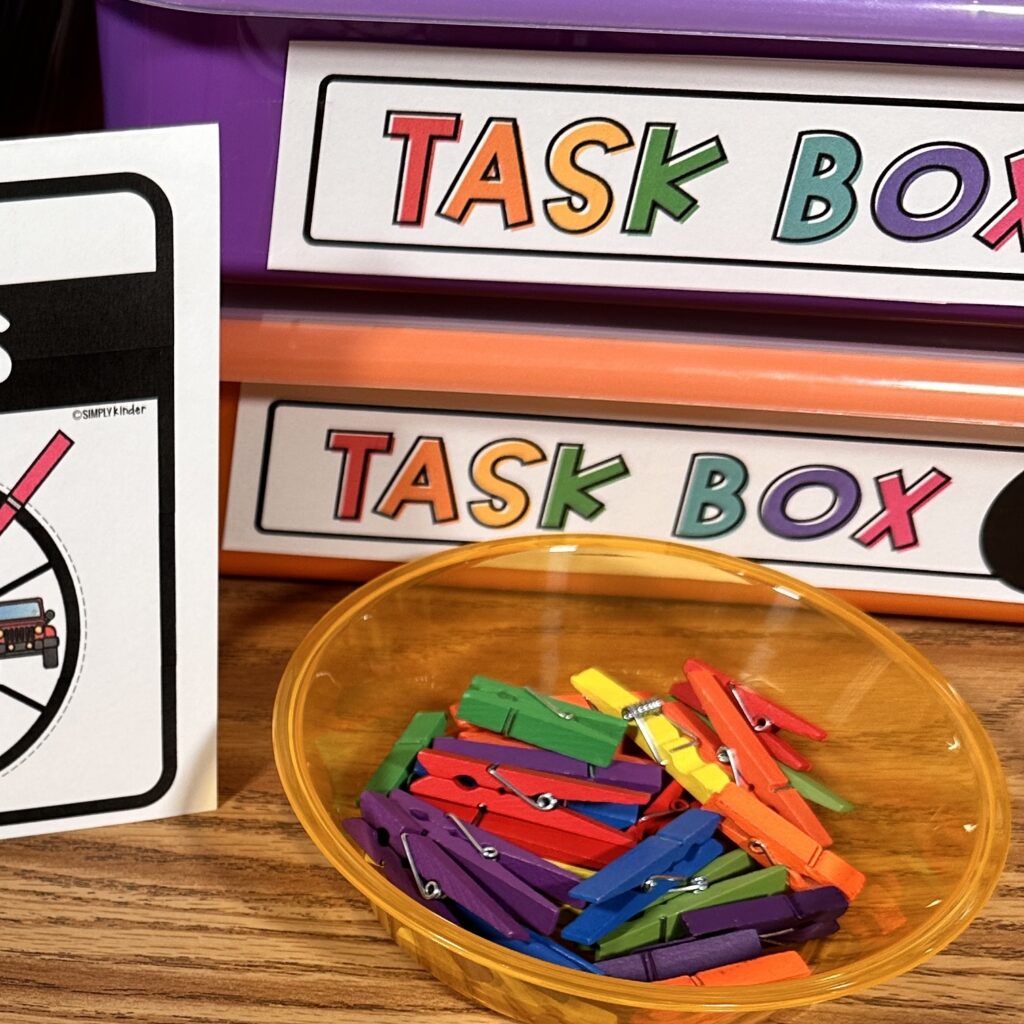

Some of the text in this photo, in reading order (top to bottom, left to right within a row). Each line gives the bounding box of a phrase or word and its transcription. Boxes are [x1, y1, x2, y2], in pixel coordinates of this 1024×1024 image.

[382, 110, 729, 236] TASK
[325, 428, 953, 554] TASK BOX
